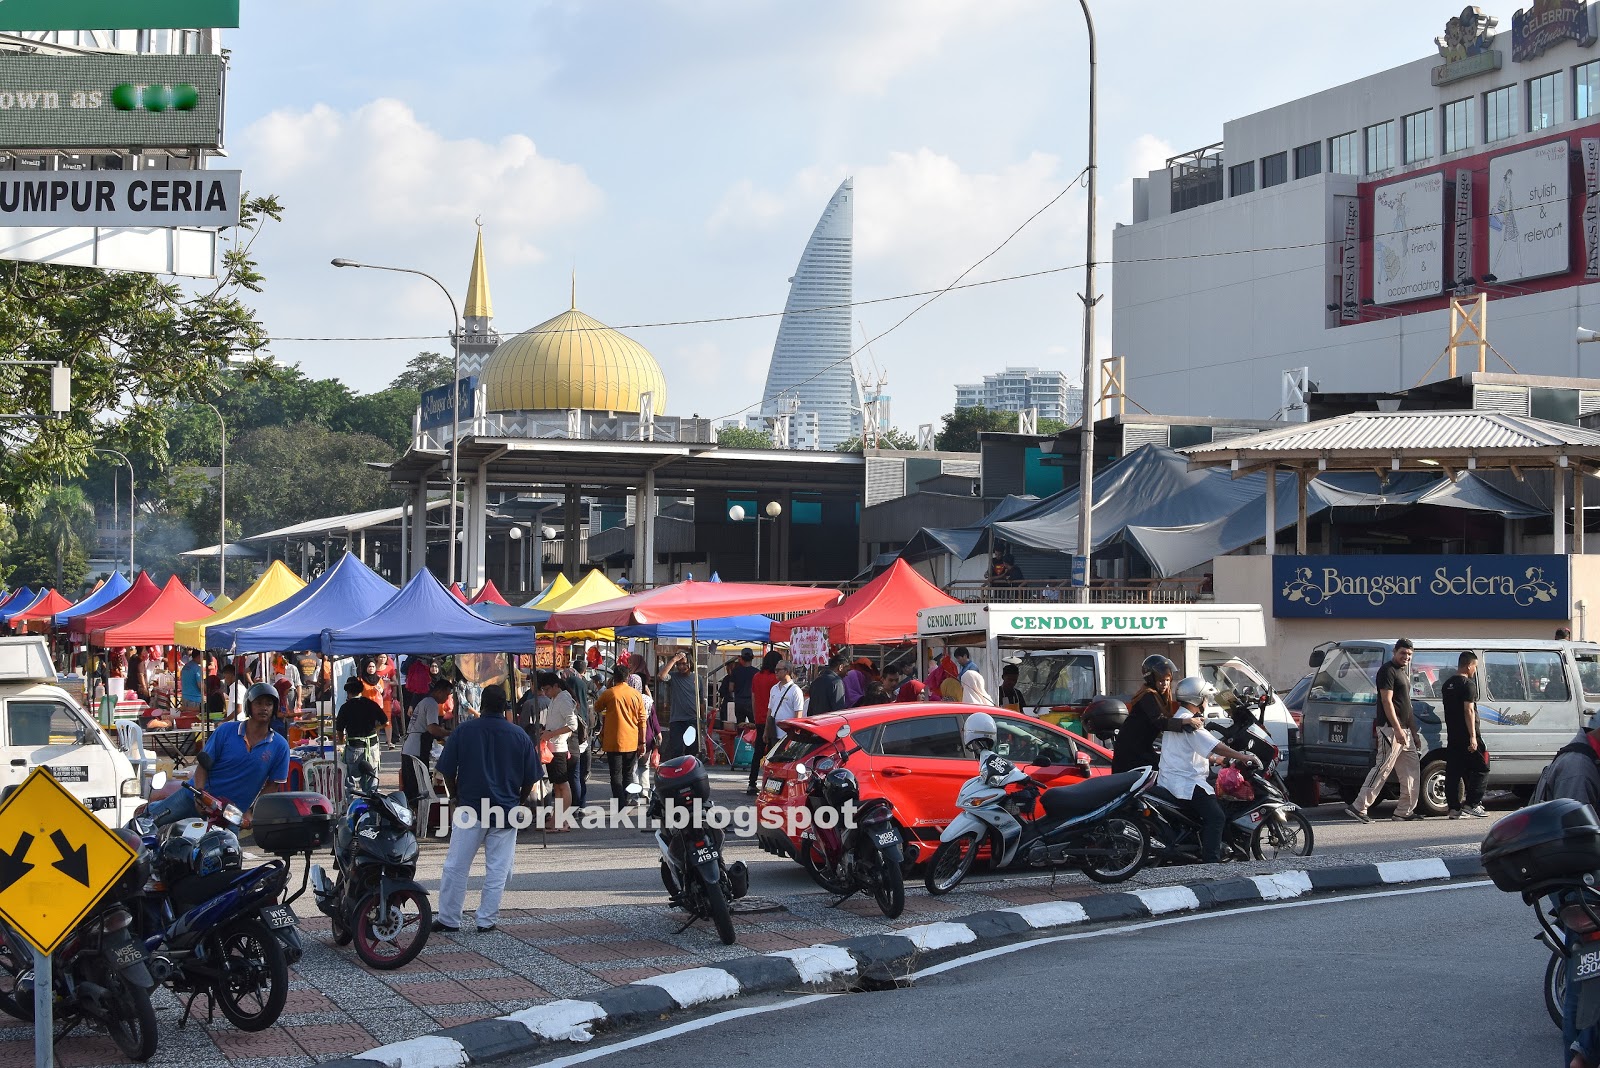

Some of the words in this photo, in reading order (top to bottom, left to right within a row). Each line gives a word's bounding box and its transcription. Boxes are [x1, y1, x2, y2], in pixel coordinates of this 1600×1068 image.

[1521, 8, 1579, 38] CELEBRITY
[0, 90, 59, 109] own
[70, 90, 102, 109] as
[127, 180, 227, 212] CERIA
[1457, 172, 1471, 228] Village
[1529, 182, 1557, 202] stylish
[1539, 206, 1546, 219] &
[1345, 201, 1358, 252] Village
[1523, 222, 1563, 243] relevant
[1411, 240, 1437, 255] friendly
[1585, 204, 1599, 278] BANGSAR
[1420, 261, 1427, 272] &
[1344, 255, 1357, 319] BNGSAR
[1321, 568, 1422, 606] Bangsar
[1429, 565, 1515, 595] Selera
[927, 613, 952, 628] CENDOL
[954, 612, 977, 627] PULUT
[1010, 616, 1094, 630] CENDOL
[1101, 616, 1168, 630] PULUT
[697, 847, 709, 856] WC
[697, 853, 712, 863] 419
[269, 908, 287, 918] WYS
[271, 915, 295, 926] 3726
[114, 943, 136, 957] WSE
